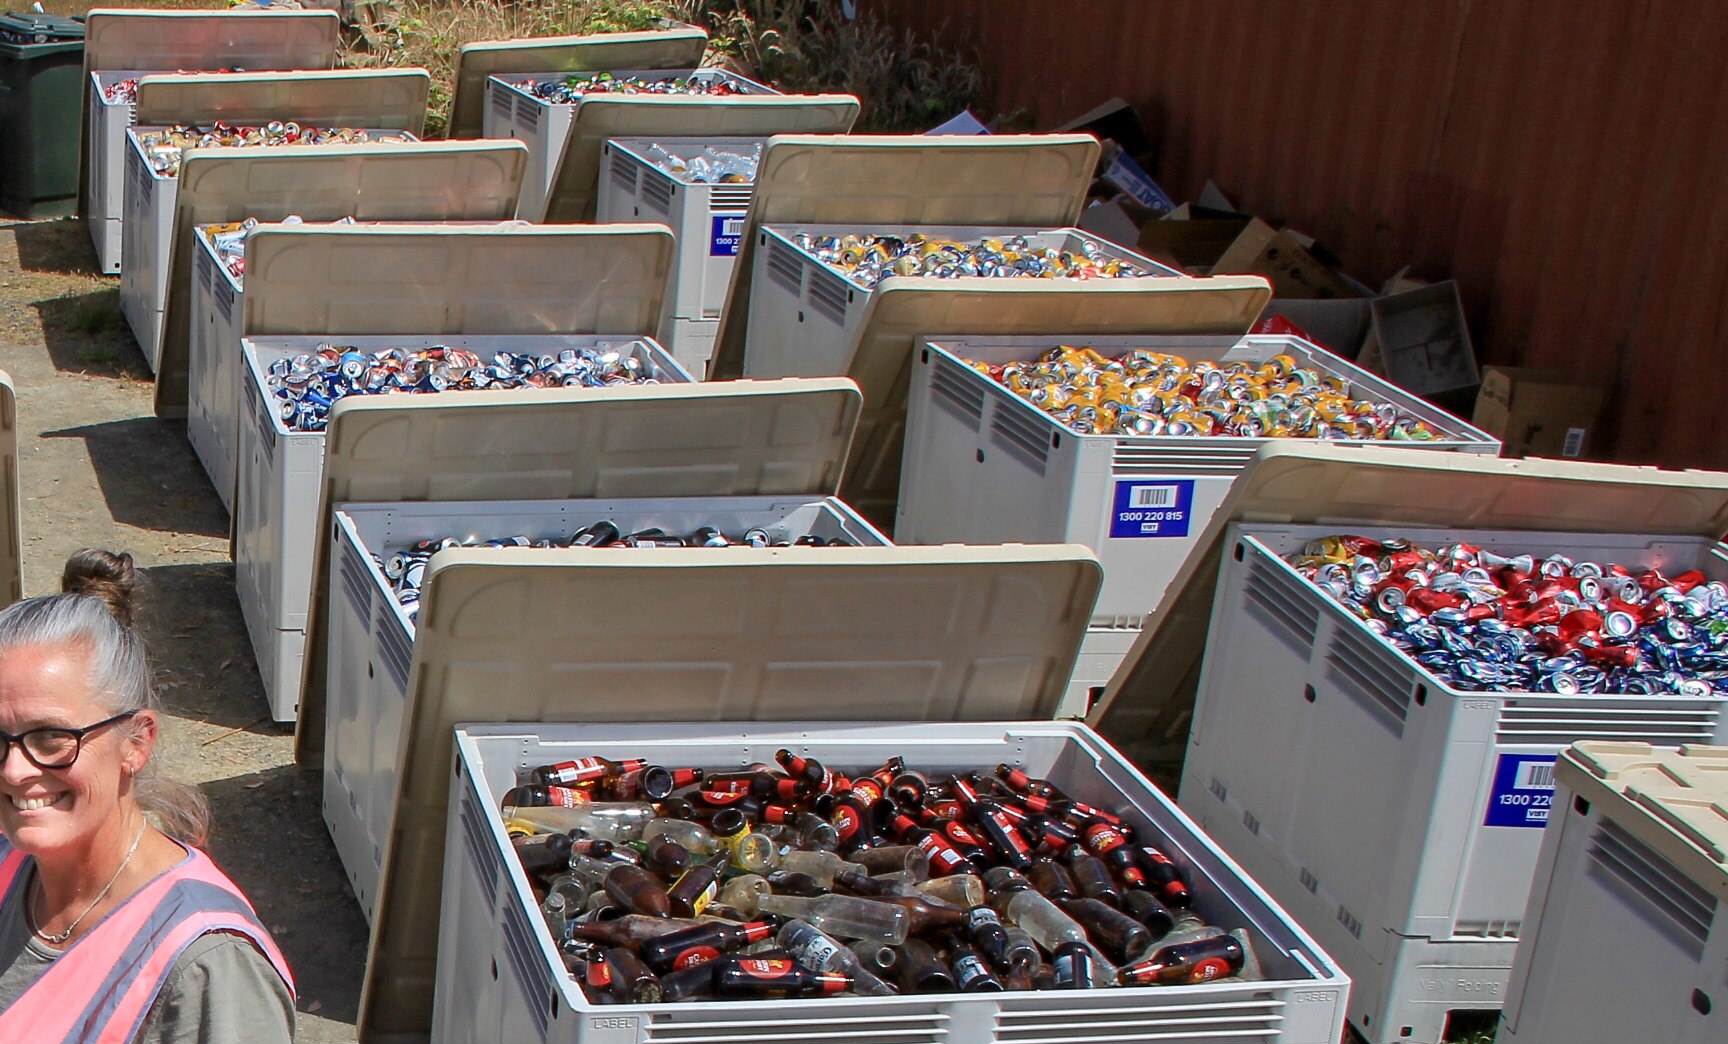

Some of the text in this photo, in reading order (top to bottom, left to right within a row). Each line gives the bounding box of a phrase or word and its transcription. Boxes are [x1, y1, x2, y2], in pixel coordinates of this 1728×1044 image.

[1119, 511, 1183, 521] 1300 220 815
[1500, 794, 1530, 806] 1300
[594, 1018, 633, 1029] LABEL
